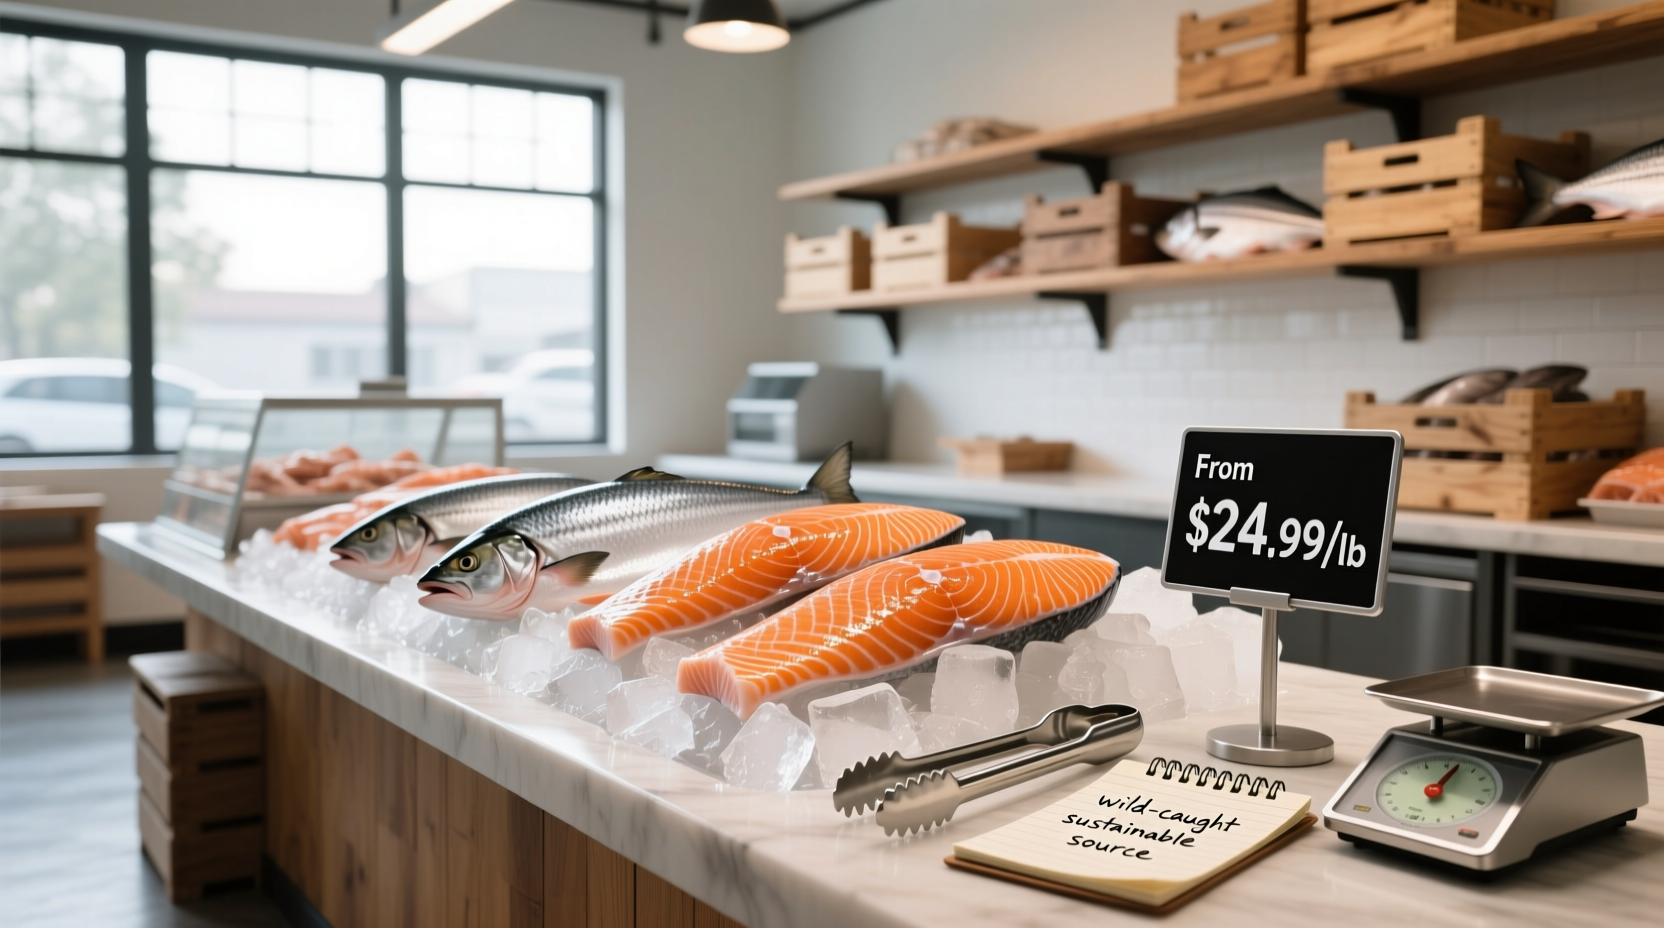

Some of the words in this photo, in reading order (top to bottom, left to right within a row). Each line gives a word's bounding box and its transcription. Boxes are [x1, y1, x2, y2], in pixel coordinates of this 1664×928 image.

[1195, 454, 1254, 481] From
[1185, 496, 1366, 569] $24.99/lb
[1062, 813, 1195, 848] sustainable
[1098, 795, 1240, 834] wild-caught
[1066, 835, 1152, 860] source
